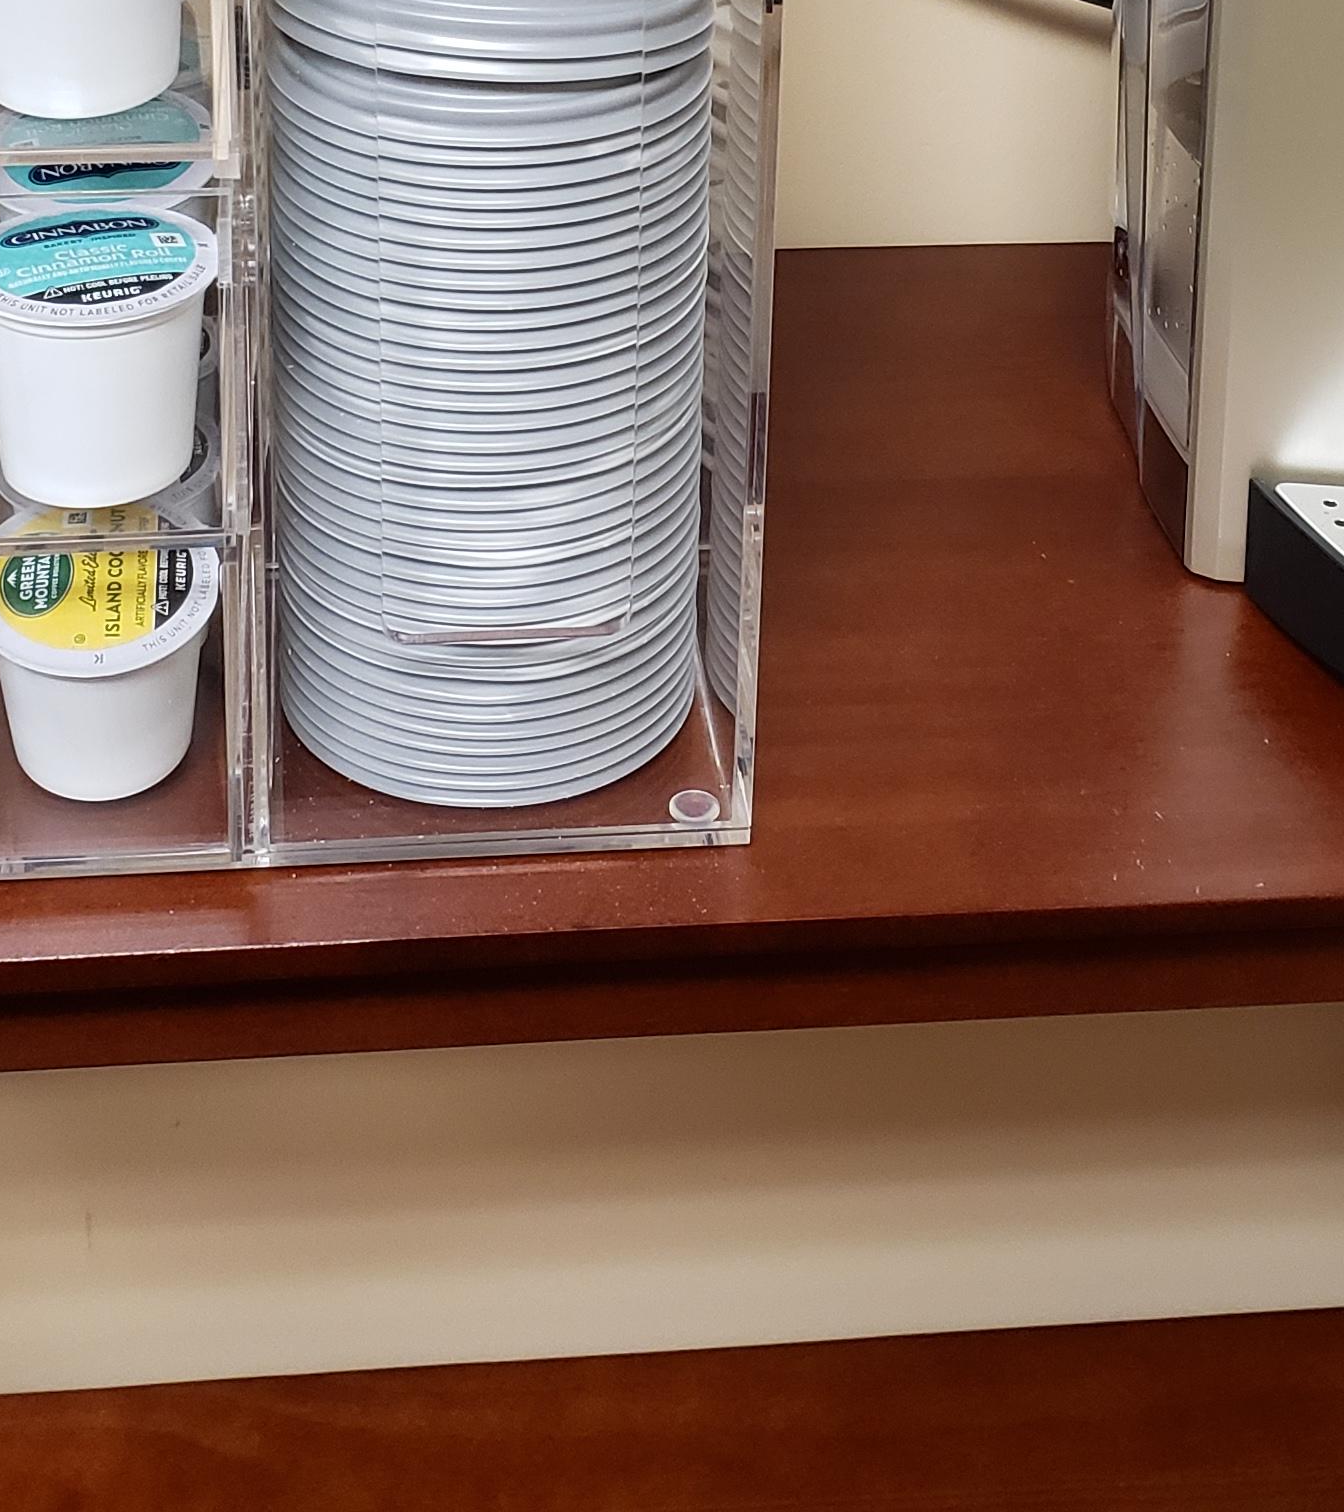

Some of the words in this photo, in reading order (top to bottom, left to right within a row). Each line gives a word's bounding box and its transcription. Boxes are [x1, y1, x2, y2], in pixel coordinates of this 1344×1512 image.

[10, 217, 150, 245] CINNABON
[56, 242, 128, 261] Classic
[15, 252, 125, 278] Cinnamon
[131, 246, 173, 258] Roll
[20, 303, 47, 315] UNIT
[50, 308, 74, 316] NOT
[78, 303, 135, 316] LABELED
[137, 296, 159, 308] FOR
[160, 276, 192, 301] RETAIL
[189, 263, 206, 280] SALE
[80, 285, 143, 303] KEURIG
[86, 280, 108, 290] COOL
[19, 556, 36, 600] GREEN
[33, 554, 51, 609] MOUNTA
[136, 549, 149, 580] FLAVORE
[173, 549, 187, 591] KEURIG
[78, 568, 97, 612] Limited
[104, 581, 122, 638] ISLAND
[134, 579, 147, 628] ARTIFICIALLY
[142, 635, 166, 652] THIS
[167, 618, 189, 639] UNIT
[186, 600, 202, 622] NOT
